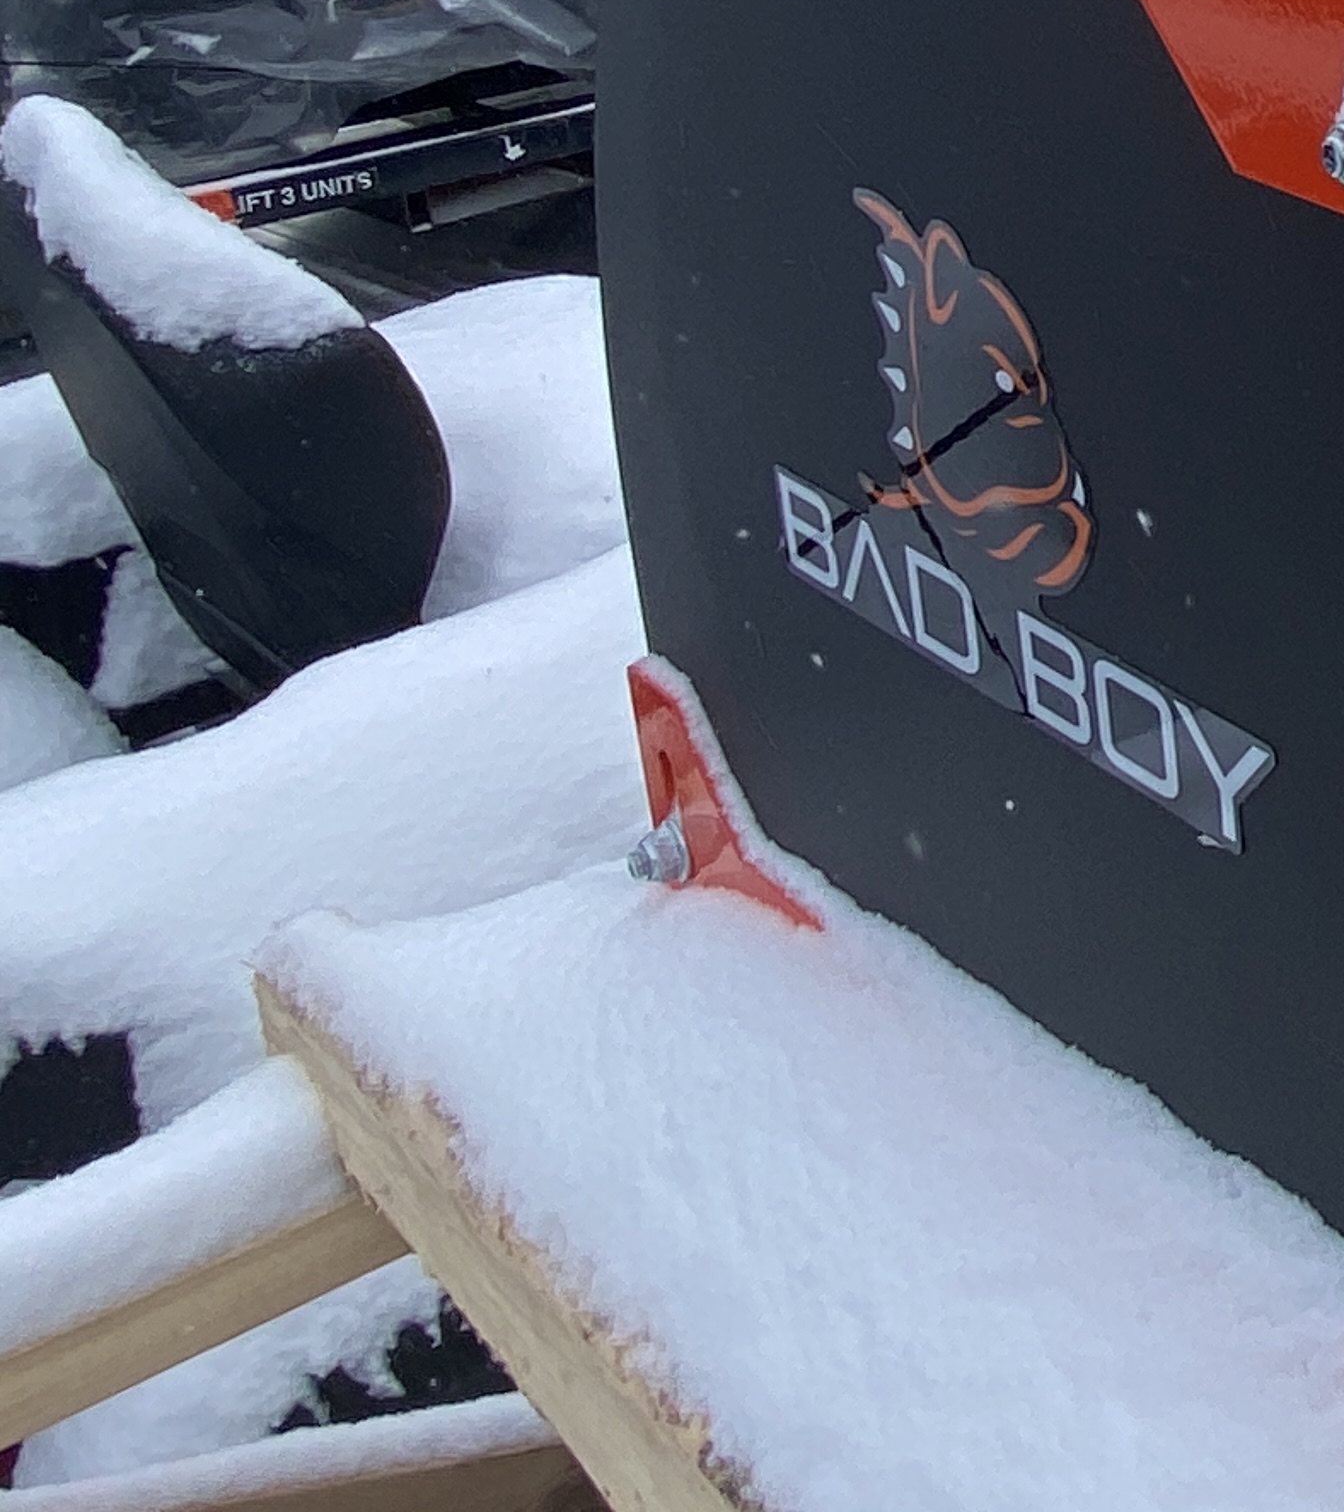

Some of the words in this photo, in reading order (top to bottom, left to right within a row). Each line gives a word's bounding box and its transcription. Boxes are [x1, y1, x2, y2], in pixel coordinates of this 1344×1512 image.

[235, 190, 274, 215] IFT
[280, 187, 296, 206] 3
[301, 172, 372, 202] UNITS
[776, 471, 980, 675] BAD
[1017, 610, 1271, 843] BOY
